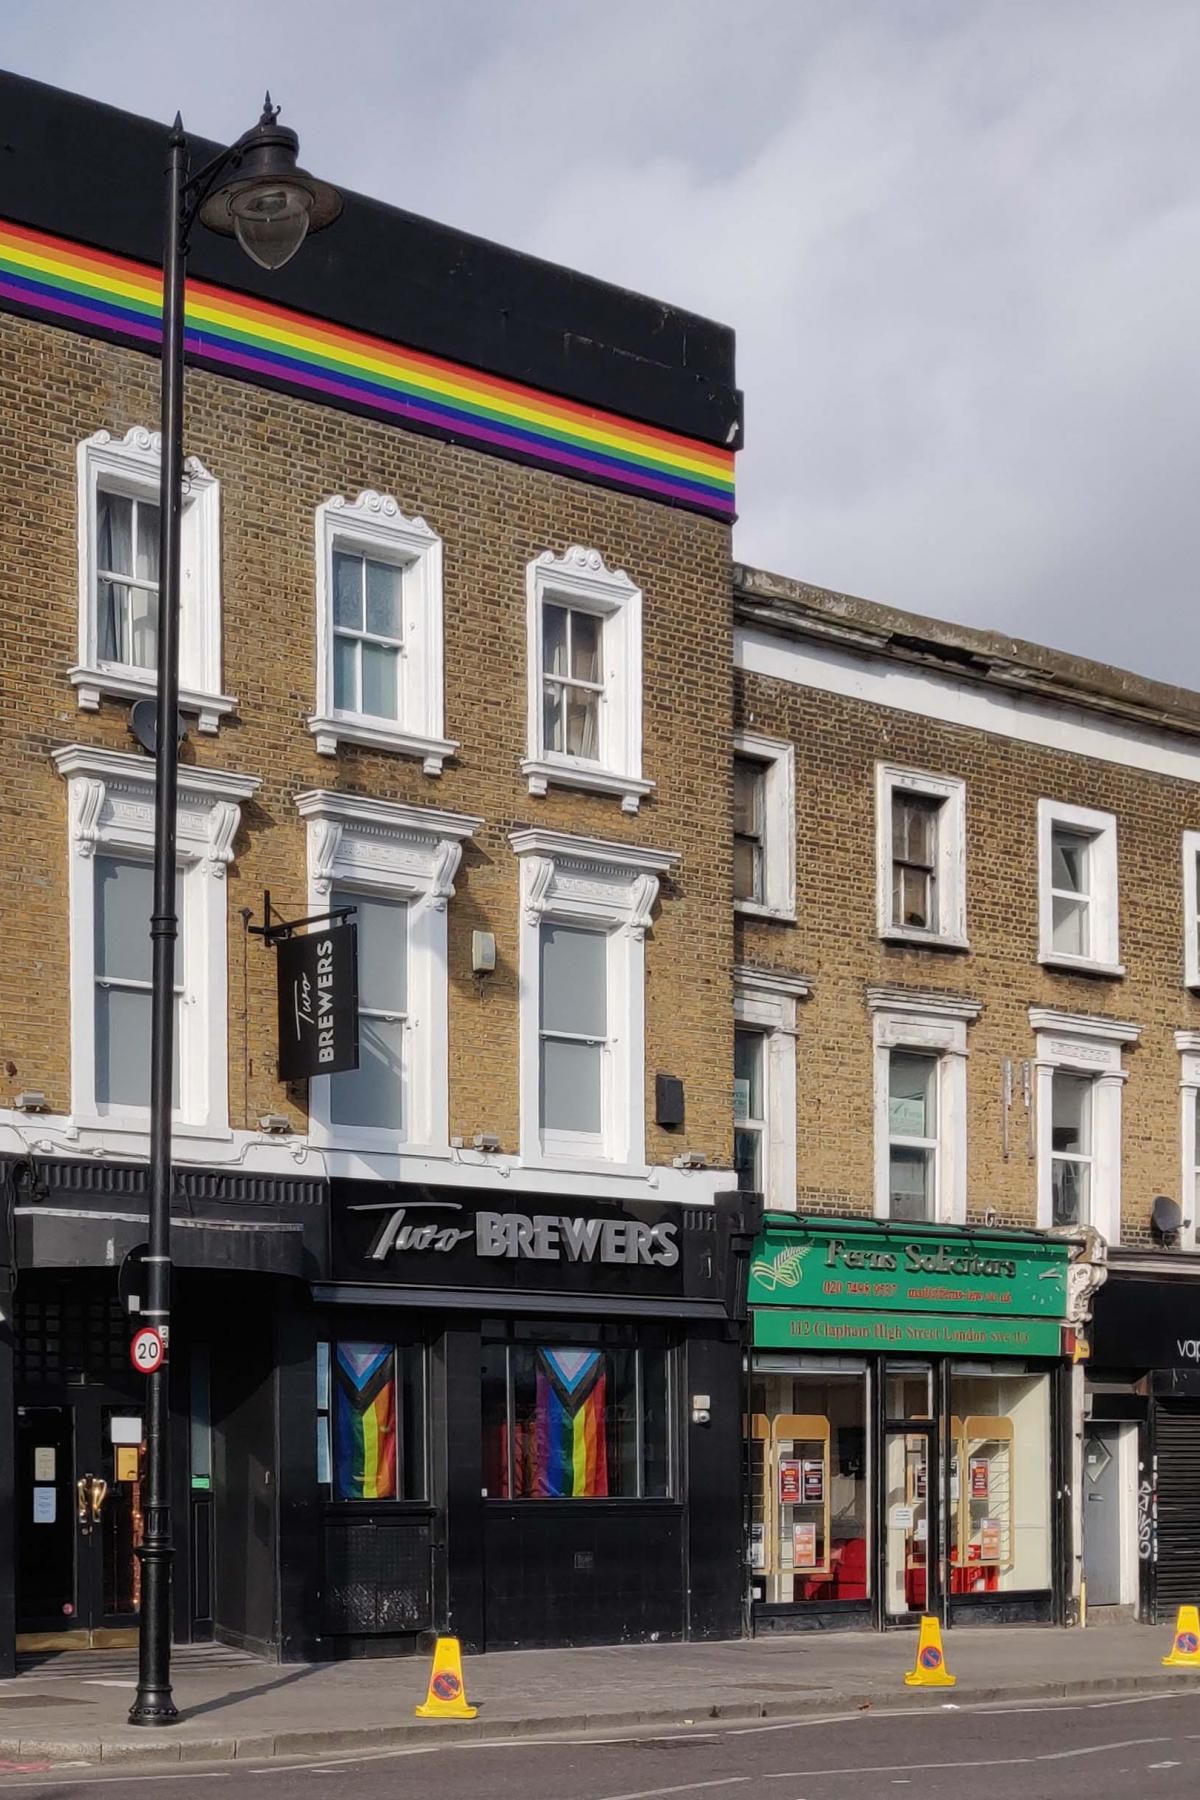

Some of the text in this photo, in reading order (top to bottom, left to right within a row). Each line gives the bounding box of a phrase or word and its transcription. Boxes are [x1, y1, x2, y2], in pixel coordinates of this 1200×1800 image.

[294, 972, 315, 1041] Two
[316, 940, 335, 1064] BREWERS
[347, 1202, 680, 1267] Two BREWERS
[824, 1238, 1017, 1279] Ferns Solicitors
[823, 1280, 842, 1295] 020
[137, 1341, 159, 1360] 20
[789, 1320, 810, 1336] 112
[813, 1321, 870, 1340] Clapham
[873, 1322, 902, 1341] High
[906, 1324, 940, 1340] Street
[943, 1326, 986, 1342] London
